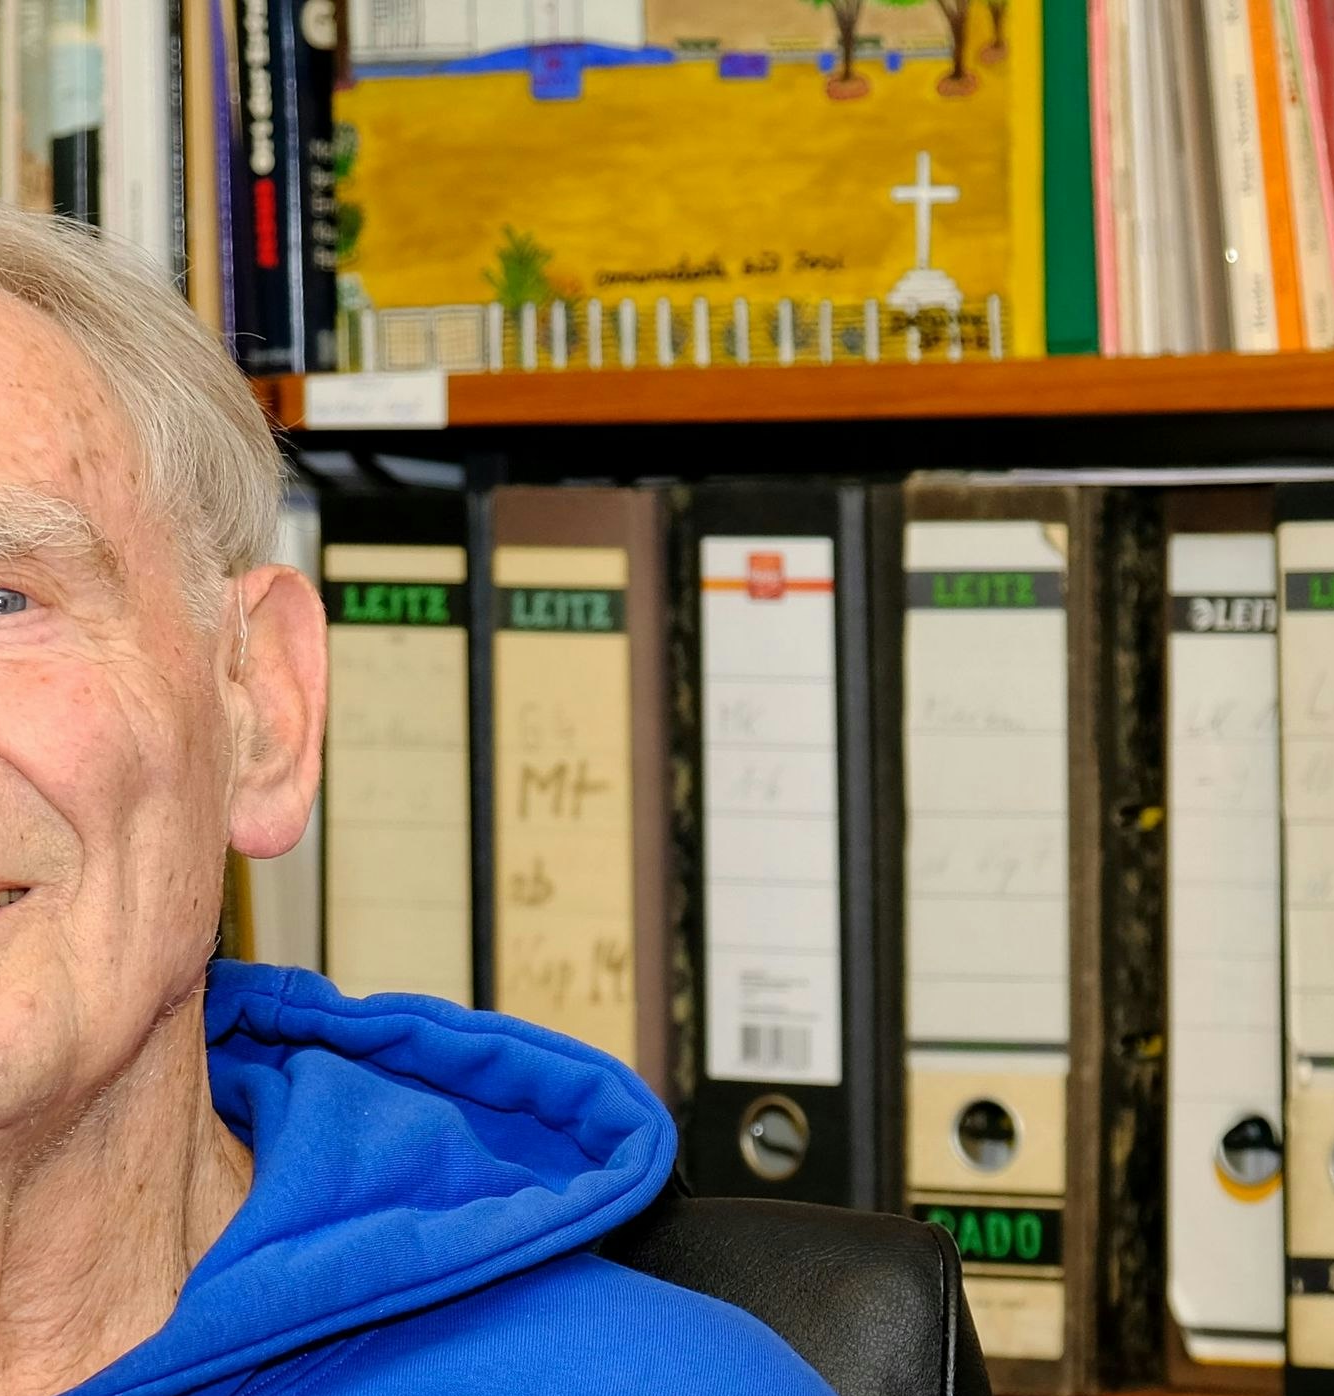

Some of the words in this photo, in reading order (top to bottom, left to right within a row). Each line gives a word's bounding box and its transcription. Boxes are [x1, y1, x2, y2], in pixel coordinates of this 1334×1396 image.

[344, 585, 449, 623] LEITZ
[933, 576, 1035, 606] LEITZ
[512, 591, 613, 629] LEITZ
[1213, 600, 1276, 630] LEIT
